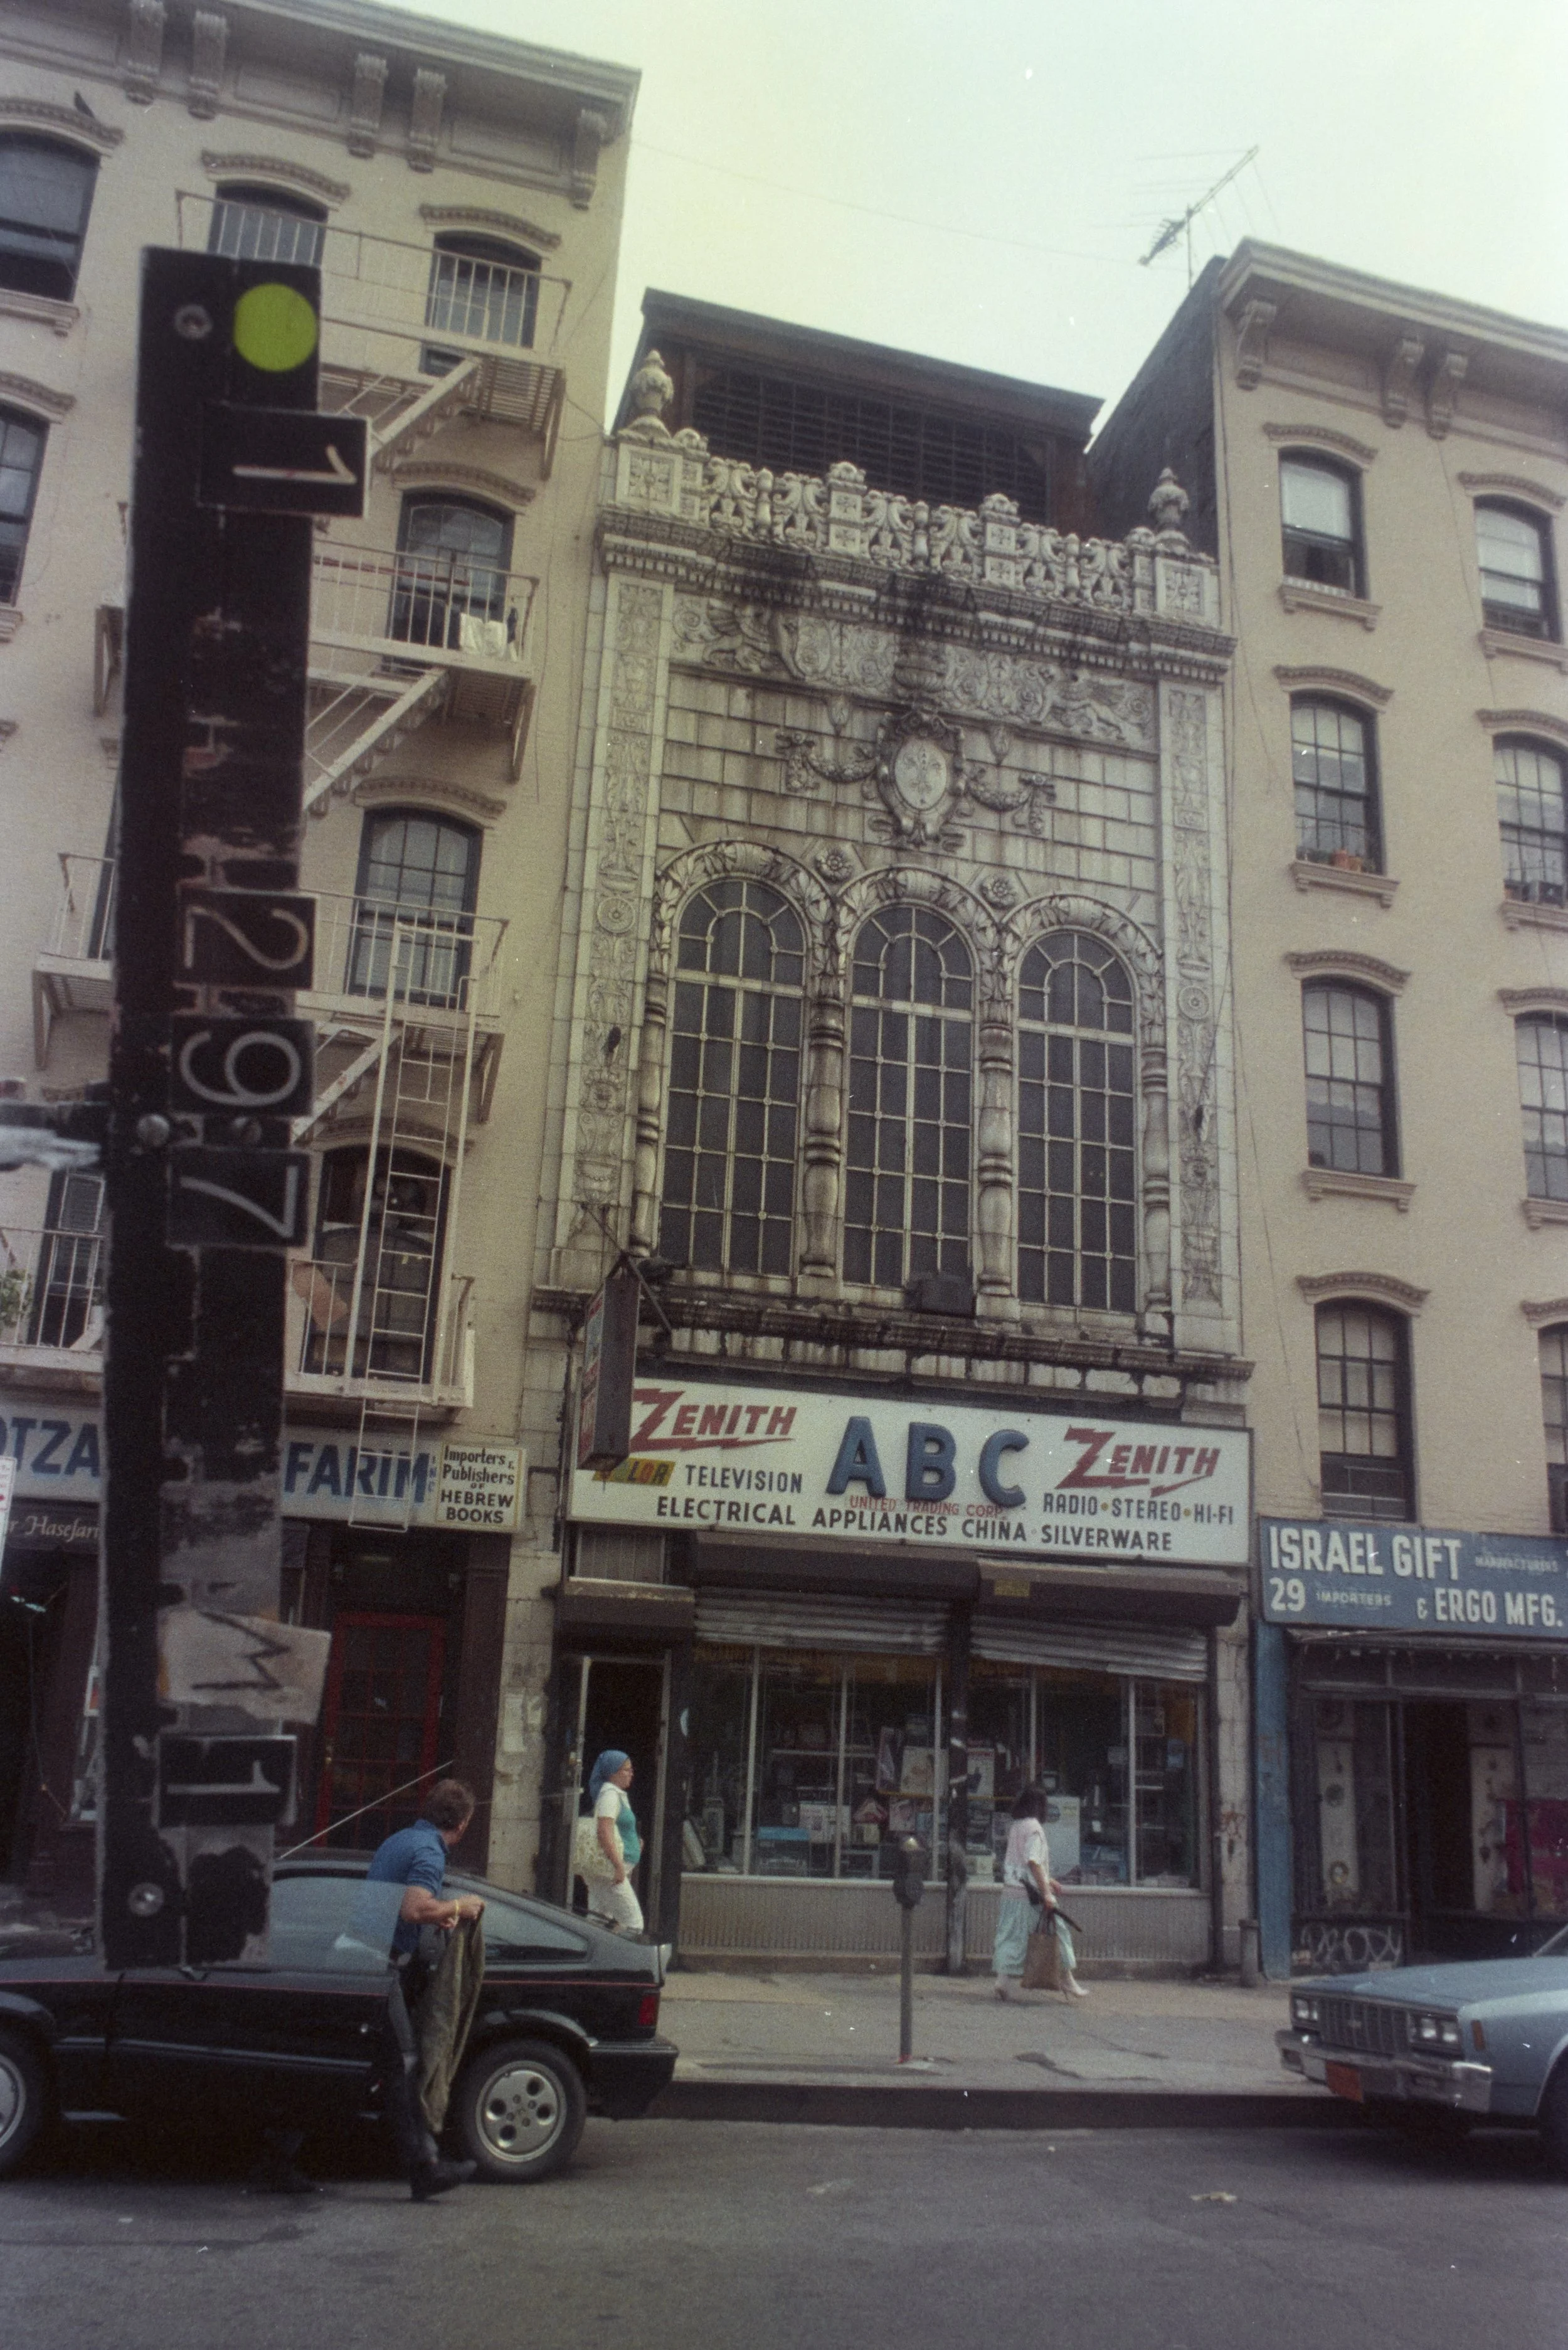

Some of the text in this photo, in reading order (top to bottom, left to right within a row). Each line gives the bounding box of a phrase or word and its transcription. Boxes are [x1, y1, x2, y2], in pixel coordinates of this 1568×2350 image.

[231, 444, 358, 485] 1
[630, 1387, 798, 1452] ZENITH
[443, 1445, 506, 1466] Importers
[1054, 1424, 1222, 1497] ZENITH
[442, 1463, 516, 1486] Publishers
[685, 1464, 803, 1494] TELEVISION
[440, 1489, 514, 1508] HEBREW
[849, 1494, 897, 1513] UNITED
[905, 1501, 960, 1516] TRADING
[1042, 1492, 1098, 1516] RADIO
[1111, 1497, 1181, 1522] STEREO
[446, 1506, 504, 1524] BOOKS
[656, 1496, 1172, 1551] ELECTRICAL APPLIANCES CHINA SILVERWARE
[1269, 1526, 1384, 1575] ISRAEL
[1392, 1534, 1462, 1581] GIFT
[1269, 1576, 1306, 1612] 29
[1416, 1597, 1428, 1620] &
[1434, 1587, 1496, 1624] ERGO
[1505, 1592, 1564, 1627] MFG.
